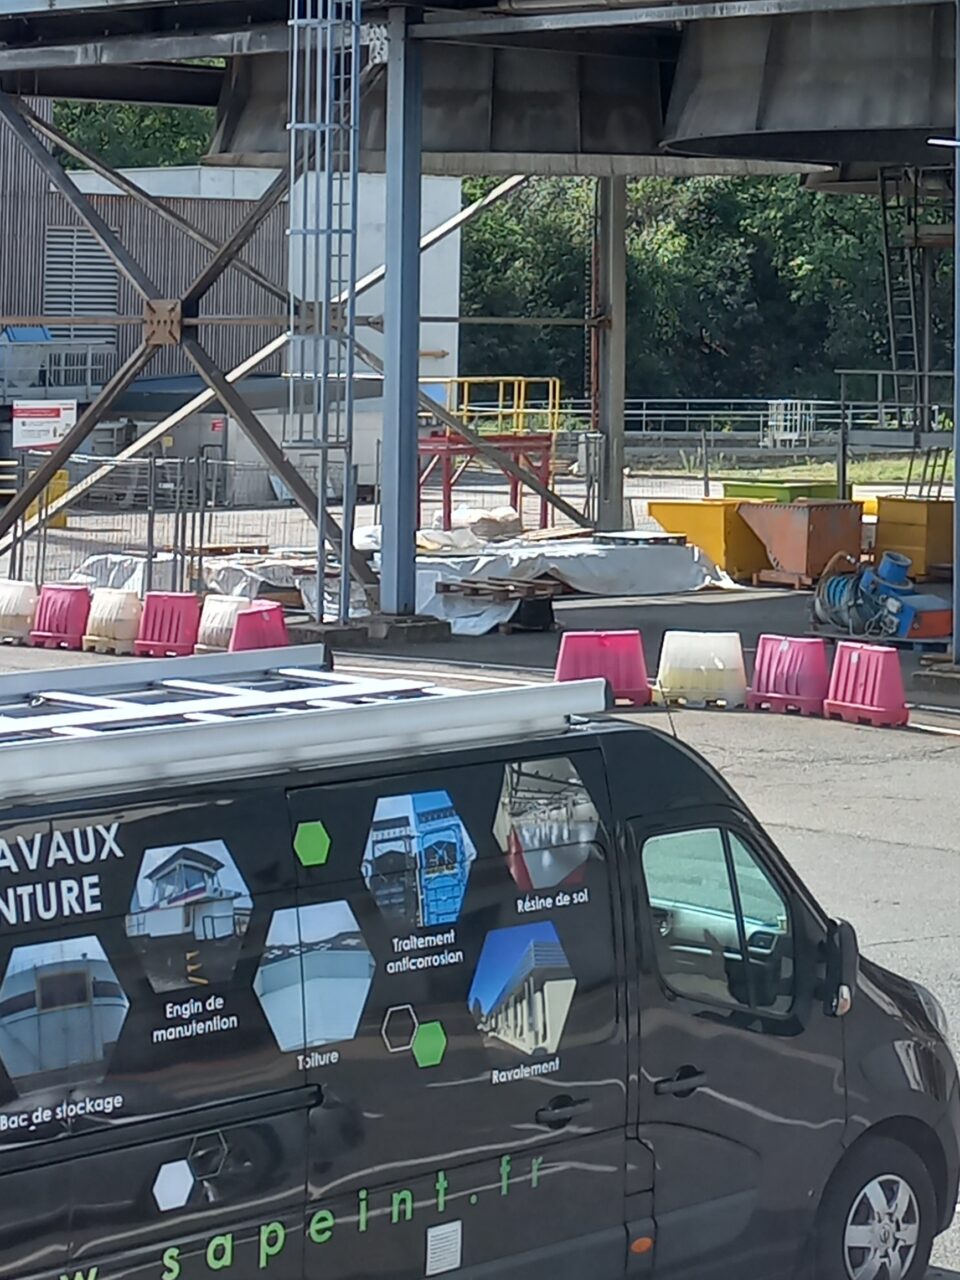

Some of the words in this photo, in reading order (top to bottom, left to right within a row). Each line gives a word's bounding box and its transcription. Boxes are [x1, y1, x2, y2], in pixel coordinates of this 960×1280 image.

[0, 822, 124, 873] AVAUX
[0, 875, 101, 925] NTURE
[517, 894, 553, 913] Résine
[556, 891, 571, 906] de
[573, 888, 588, 904] sol
[392, 929, 455, 952] Traitement
[386, 950, 463, 974] anticorrosion
[165, 999, 202, 1018] Engin
[206, 995, 224, 1011] de
[153, 1015, 237, 1043] manutention
[297, 1051, 339, 1070] Toiture
[492, 1056, 560, 1084] Ravalement
[0, 1114, 28, 1131] Bac
[32, 1107, 51, 1124] de
[56, 1095, 123, 1119] stockage
